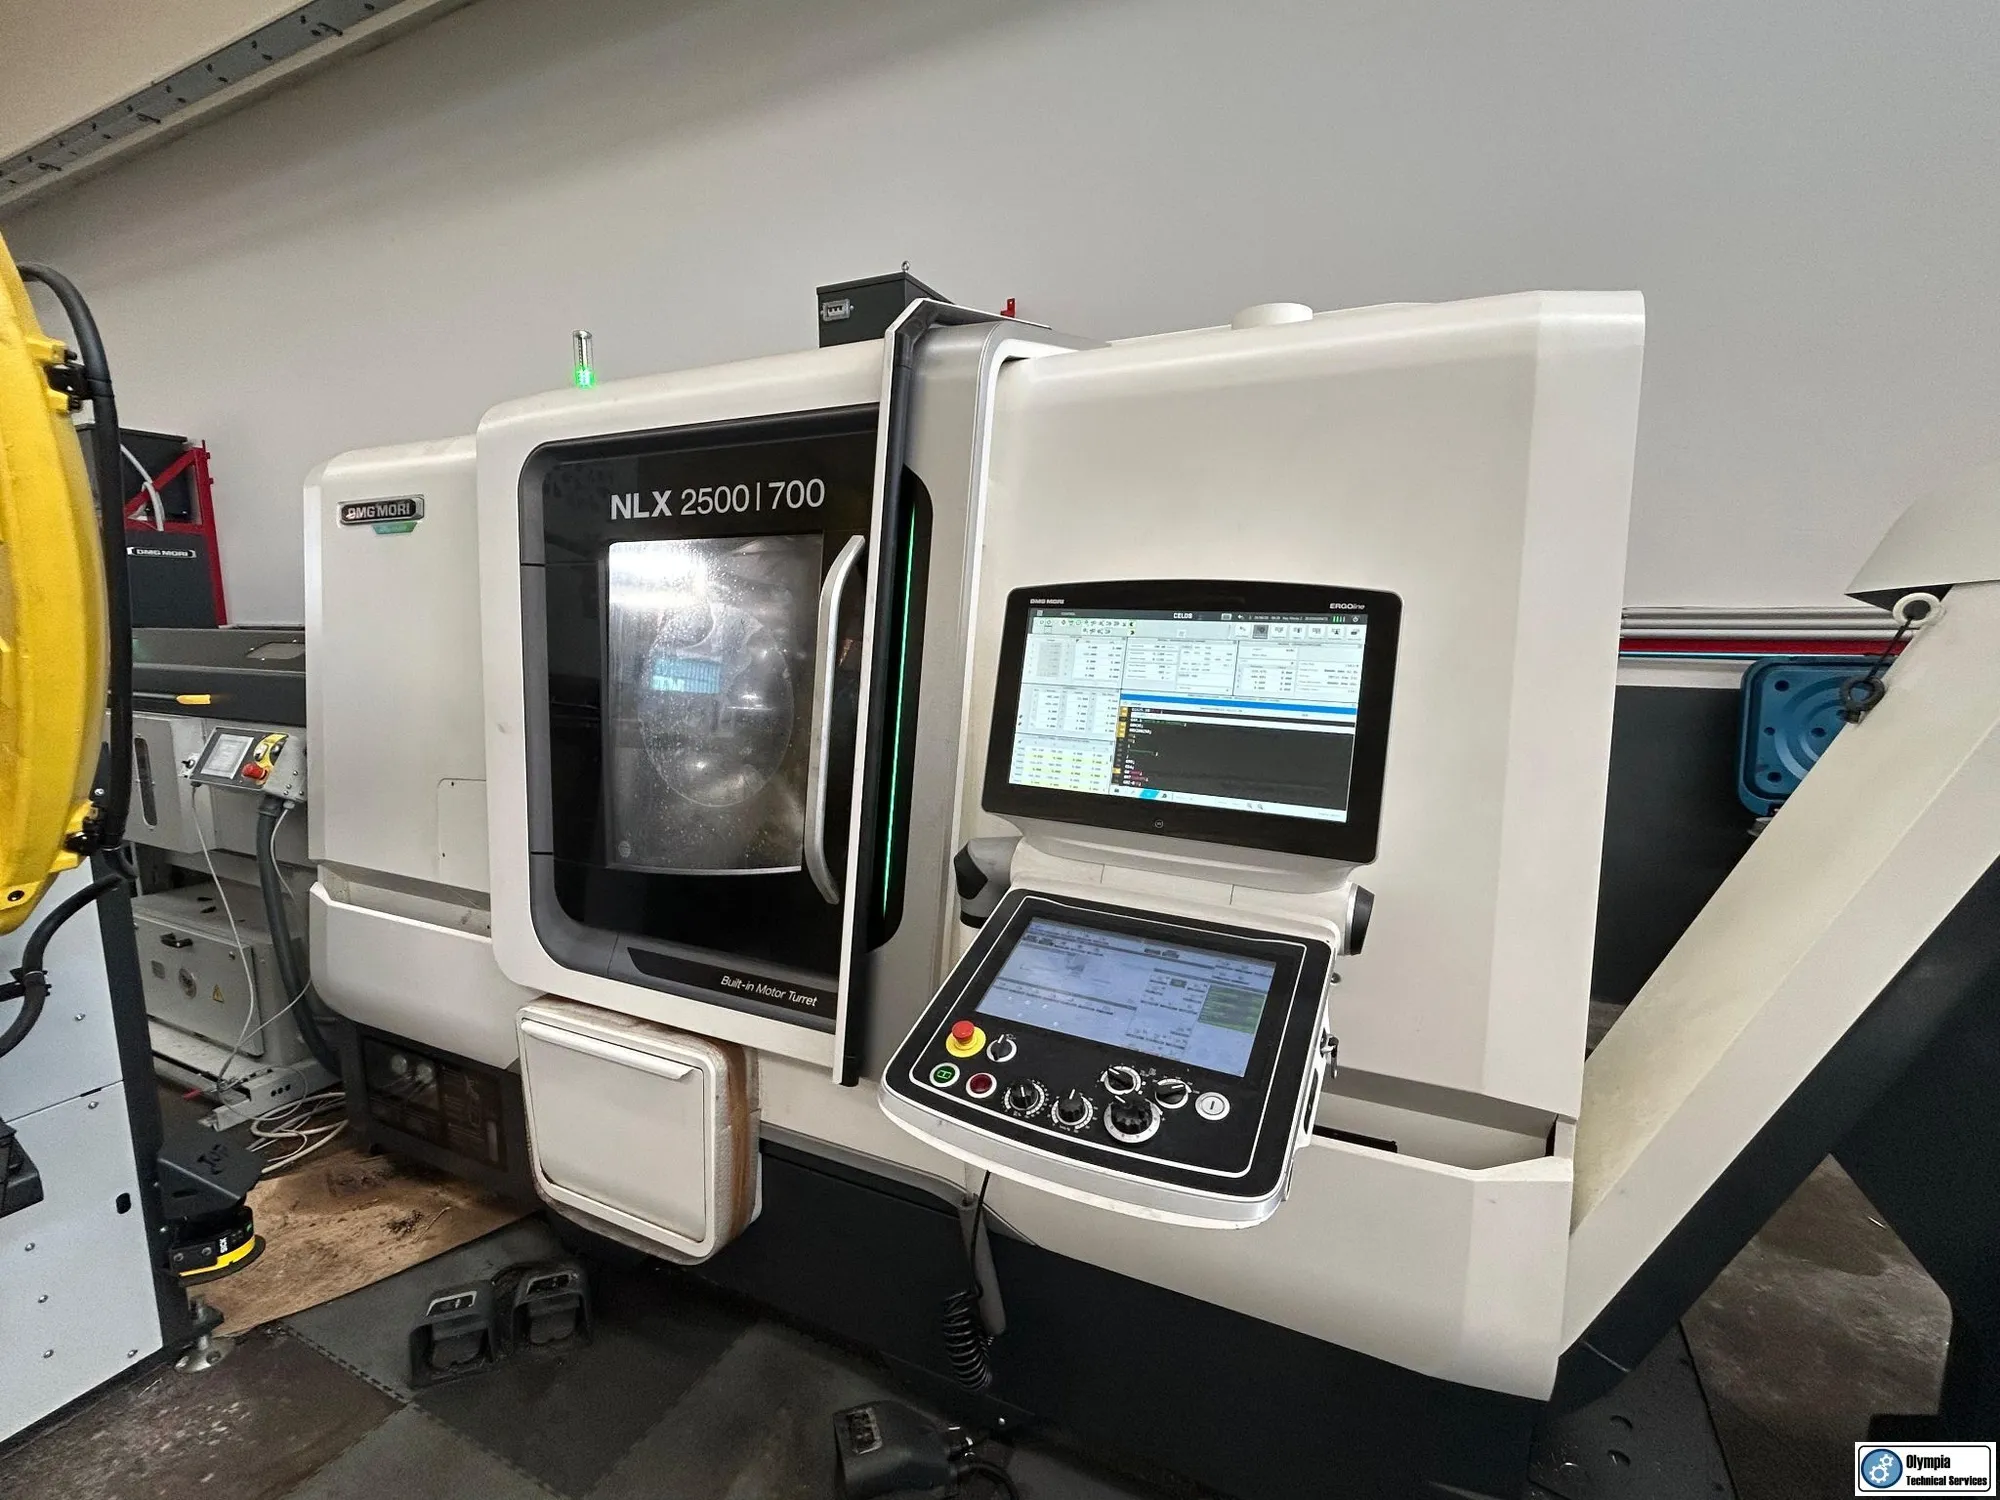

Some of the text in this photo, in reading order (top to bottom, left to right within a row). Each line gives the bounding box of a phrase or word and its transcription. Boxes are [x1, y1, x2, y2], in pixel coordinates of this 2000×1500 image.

[346, 503, 410, 519] DMG MORI
[610, 489, 672, 520] NLX
[1329, 602, 1365, 610] ERGOline
[720, 975, 818, 1007] Built-in Motor Turret
